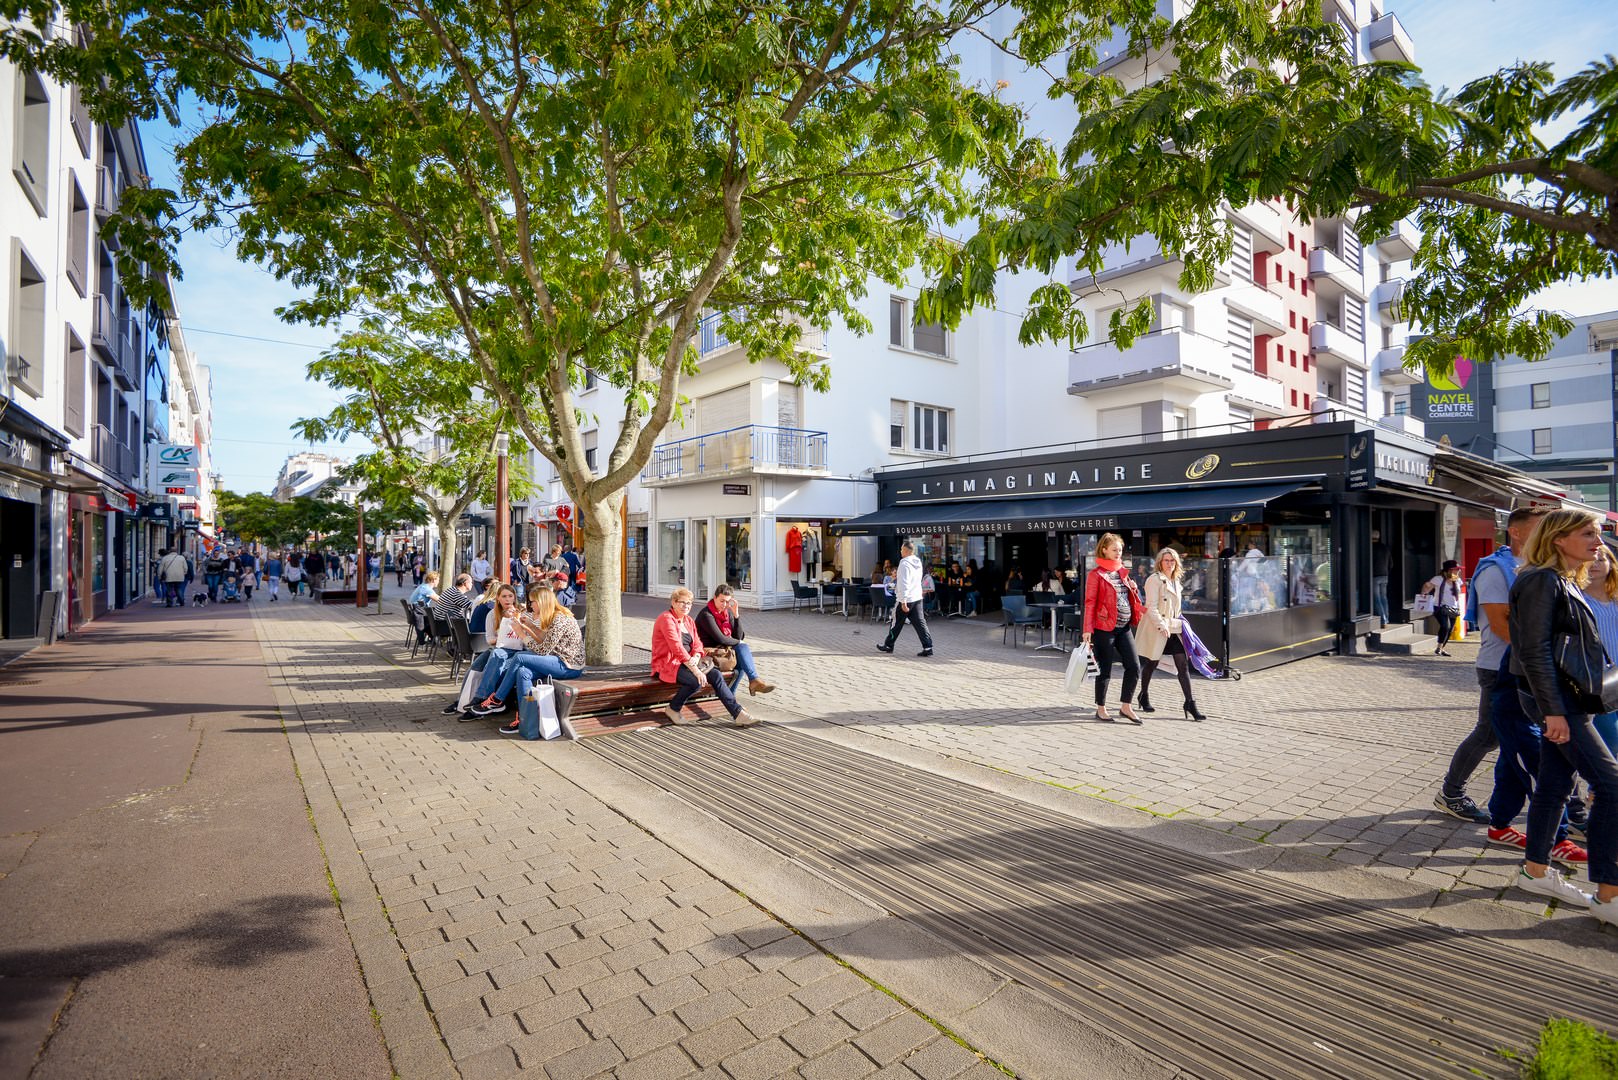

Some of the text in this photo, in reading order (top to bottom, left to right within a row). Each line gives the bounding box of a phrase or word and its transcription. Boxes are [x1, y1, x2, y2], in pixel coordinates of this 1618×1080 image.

[1428, 393, 1474, 404] NAYEL
[1429, 404, 1474, 412] CENTRE
[1377, 453, 1430, 478] MAGINAIRE
[922, 464, 1153, 495] L'IMAGINAIRE
[896, 518, 1115, 534] BOULANGERIE PATISSERIE SANDWICHERIE
